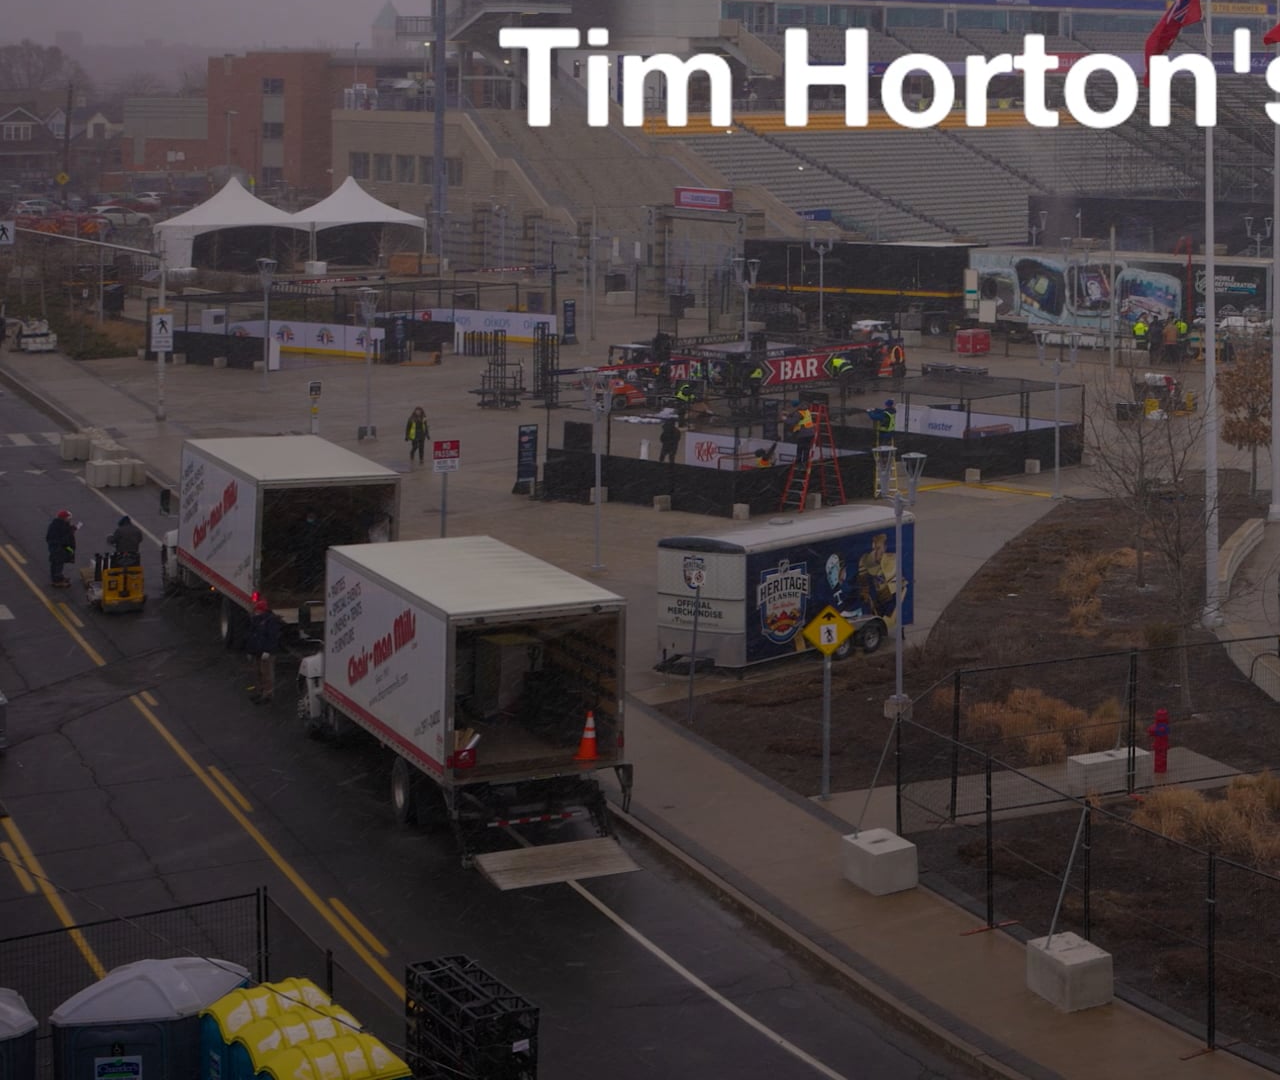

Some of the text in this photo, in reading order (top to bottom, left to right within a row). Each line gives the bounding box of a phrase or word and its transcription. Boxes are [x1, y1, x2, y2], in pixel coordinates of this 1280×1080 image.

[780, 358, 818, 380] BAR
[760, 576, 808, 601] HERITAGE
[768, 591, 800, 603] CLASSIC
[393, 608, 417, 655] Mills
